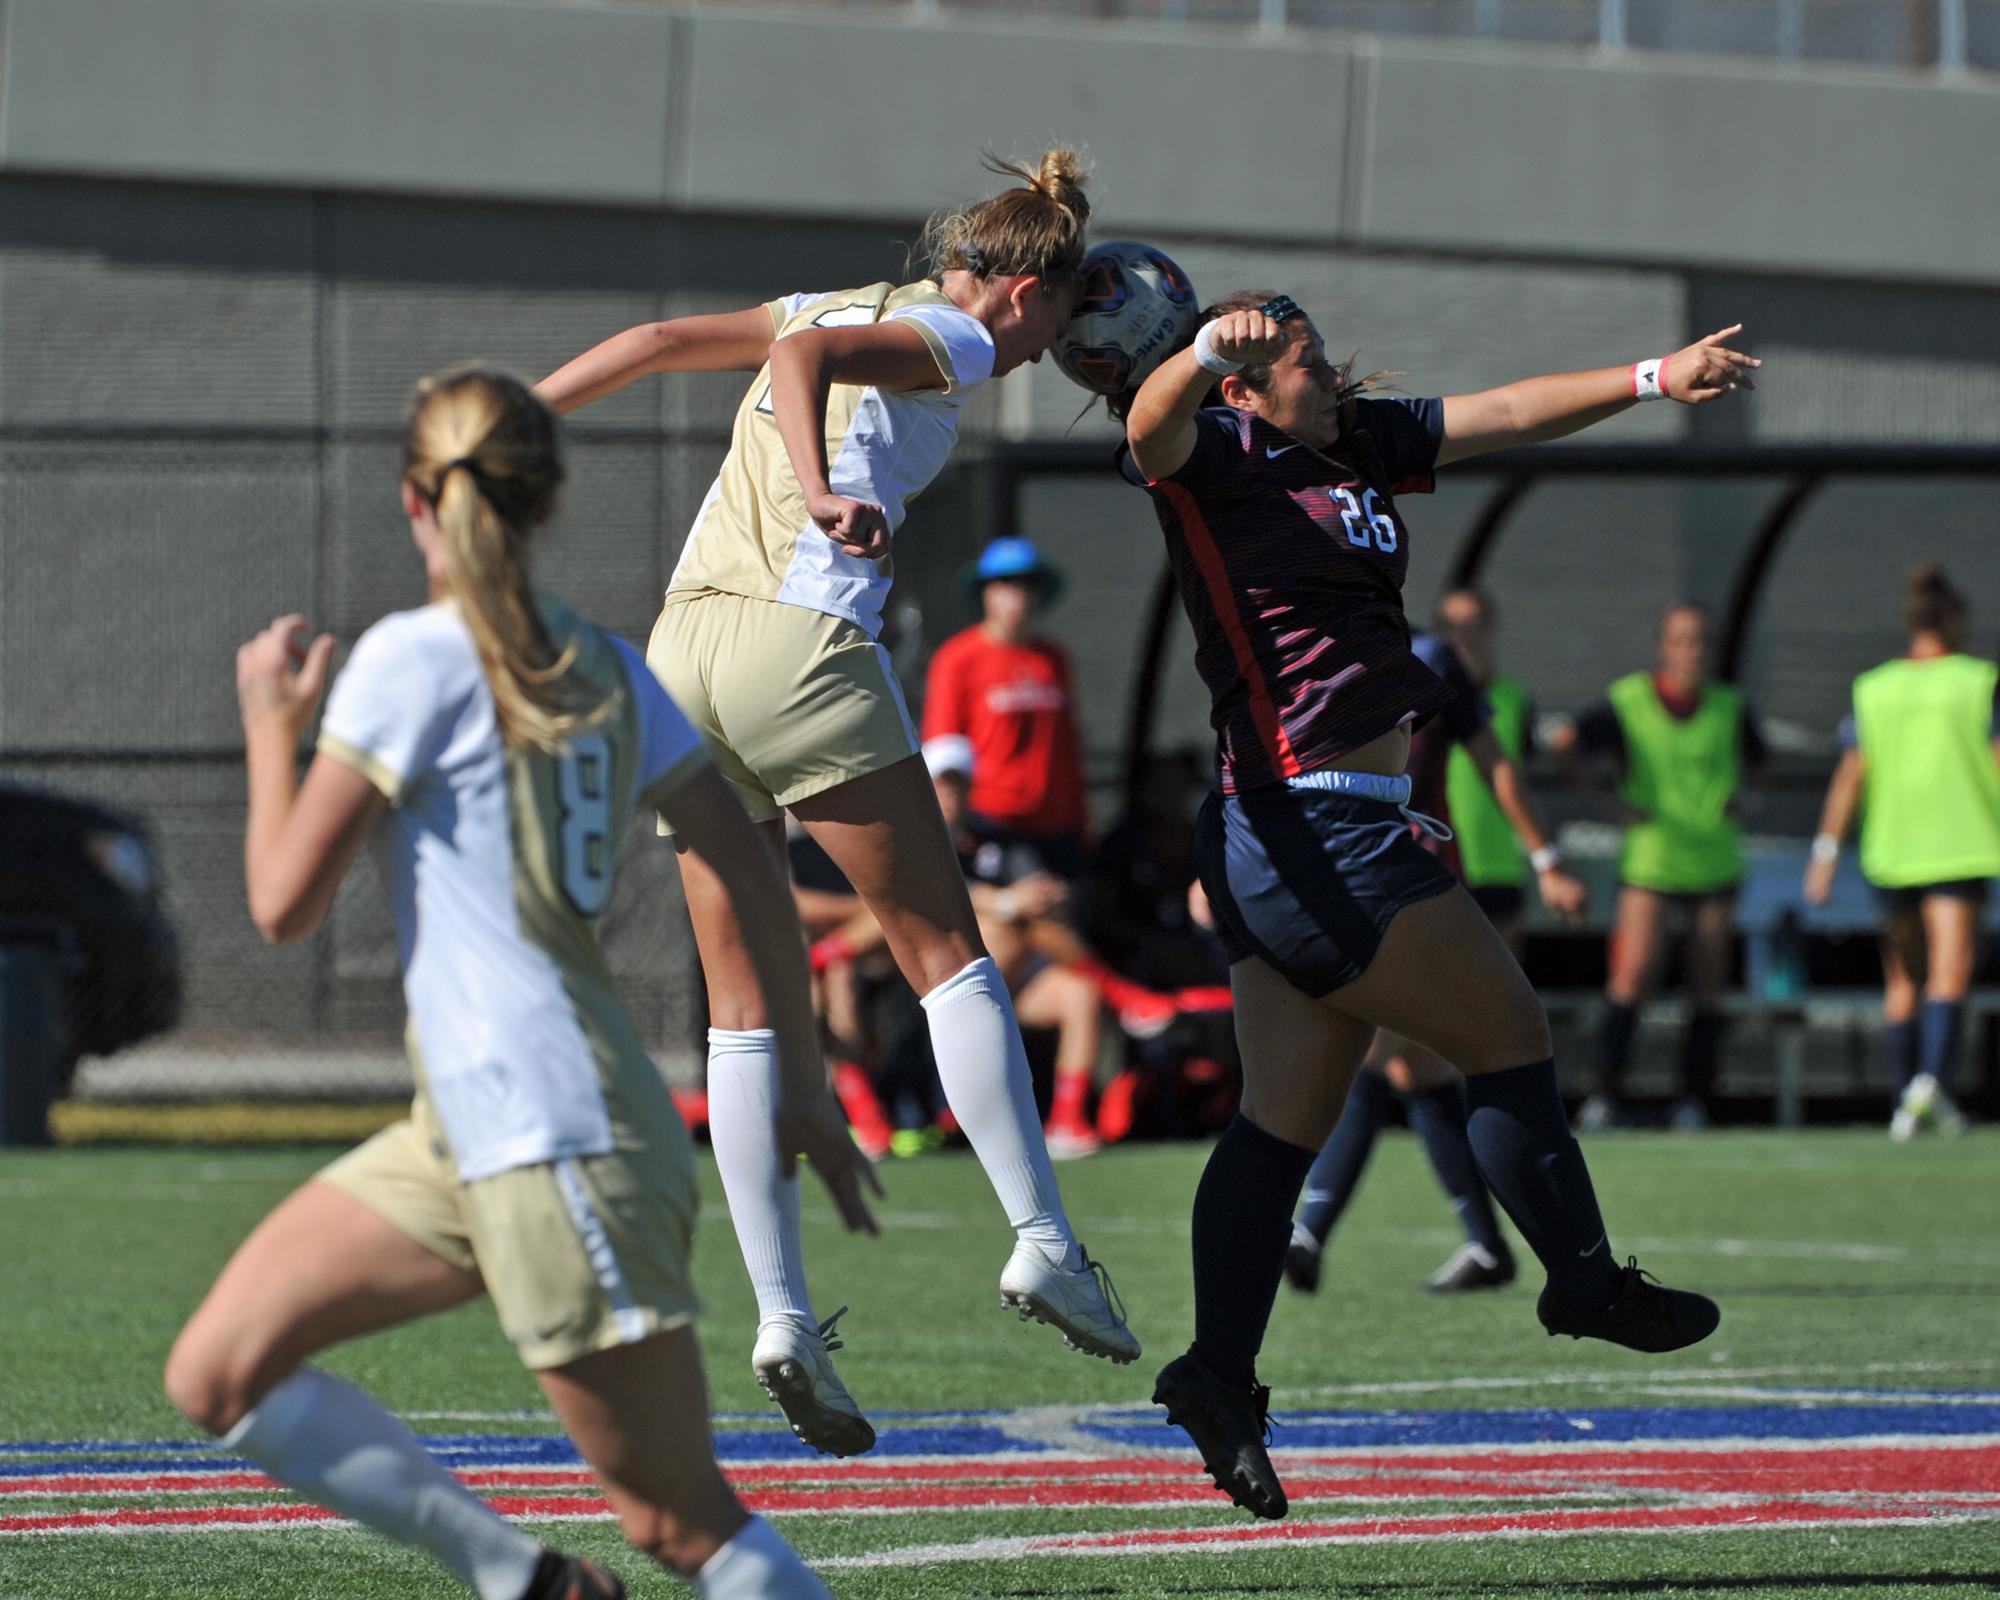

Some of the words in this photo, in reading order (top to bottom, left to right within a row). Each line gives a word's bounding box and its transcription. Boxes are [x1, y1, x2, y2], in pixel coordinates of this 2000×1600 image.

[1134, 317, 1175, 360] GAME
[1328, 486, 1398, 554] 26
[556, 731, 614, 915] 8
